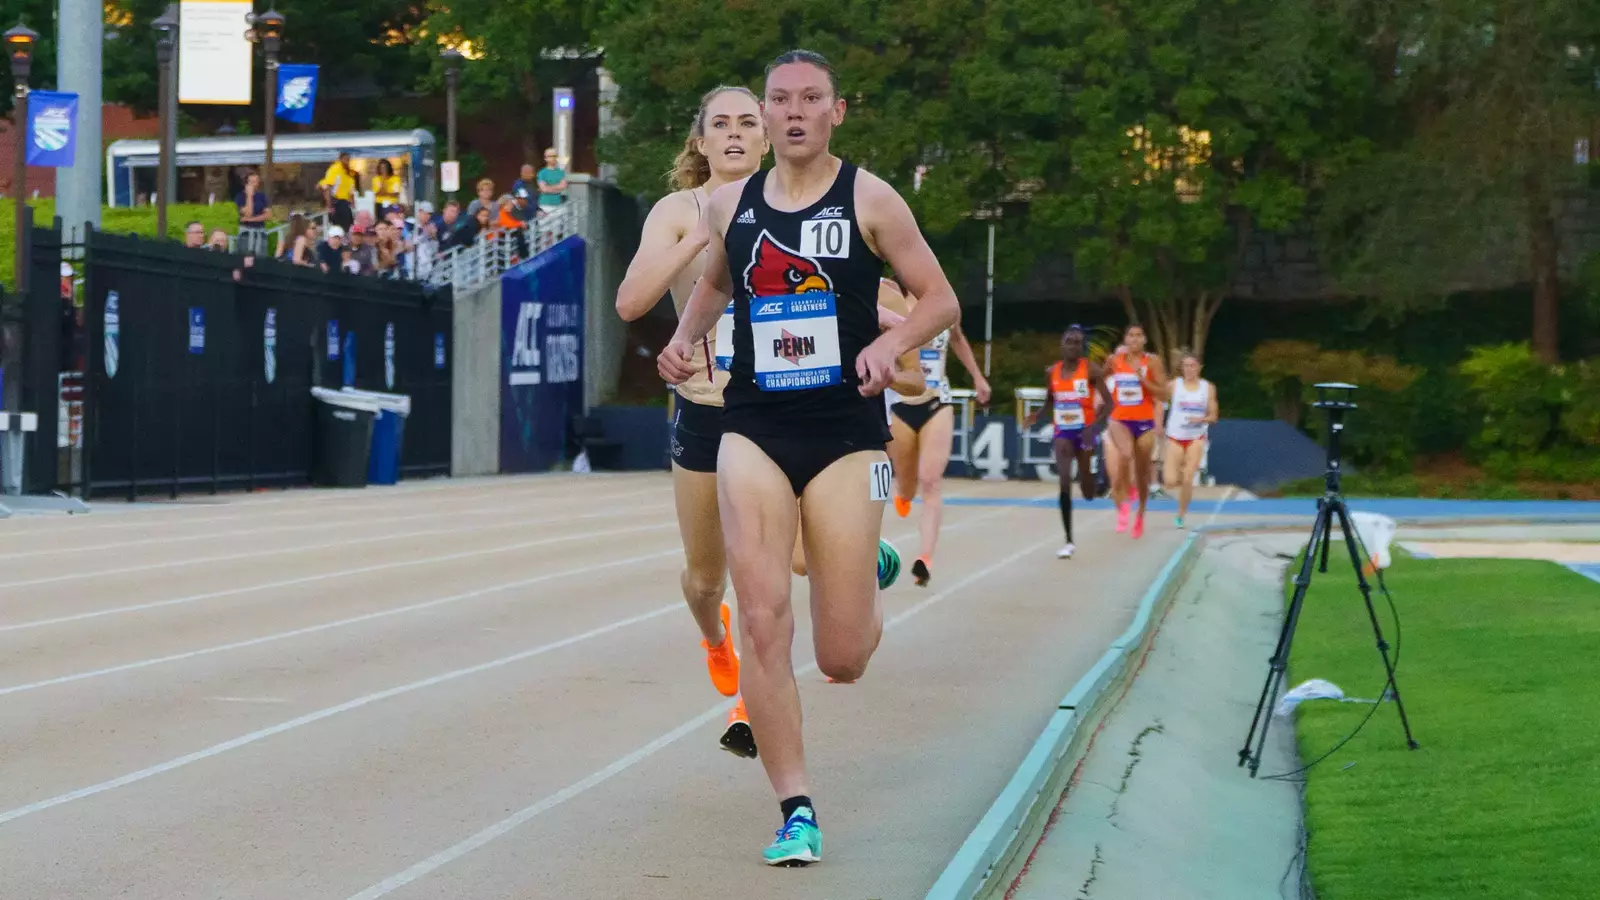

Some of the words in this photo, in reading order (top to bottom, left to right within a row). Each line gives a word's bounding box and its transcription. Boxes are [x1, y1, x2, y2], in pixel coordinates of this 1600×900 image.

[811, 206, 844, 219] ACC
[811, 221, 843, 255] 10
[756, 302, 784, 315] ACC
[790, 302, 828, 313] GREATNESS
[773, 335, 816, 358] PENN
[765, 374, 831, 388] CHAMPIONSHIPS
[971, 421, 1010, 481] 4
[874, 463, 890, 498] 10
